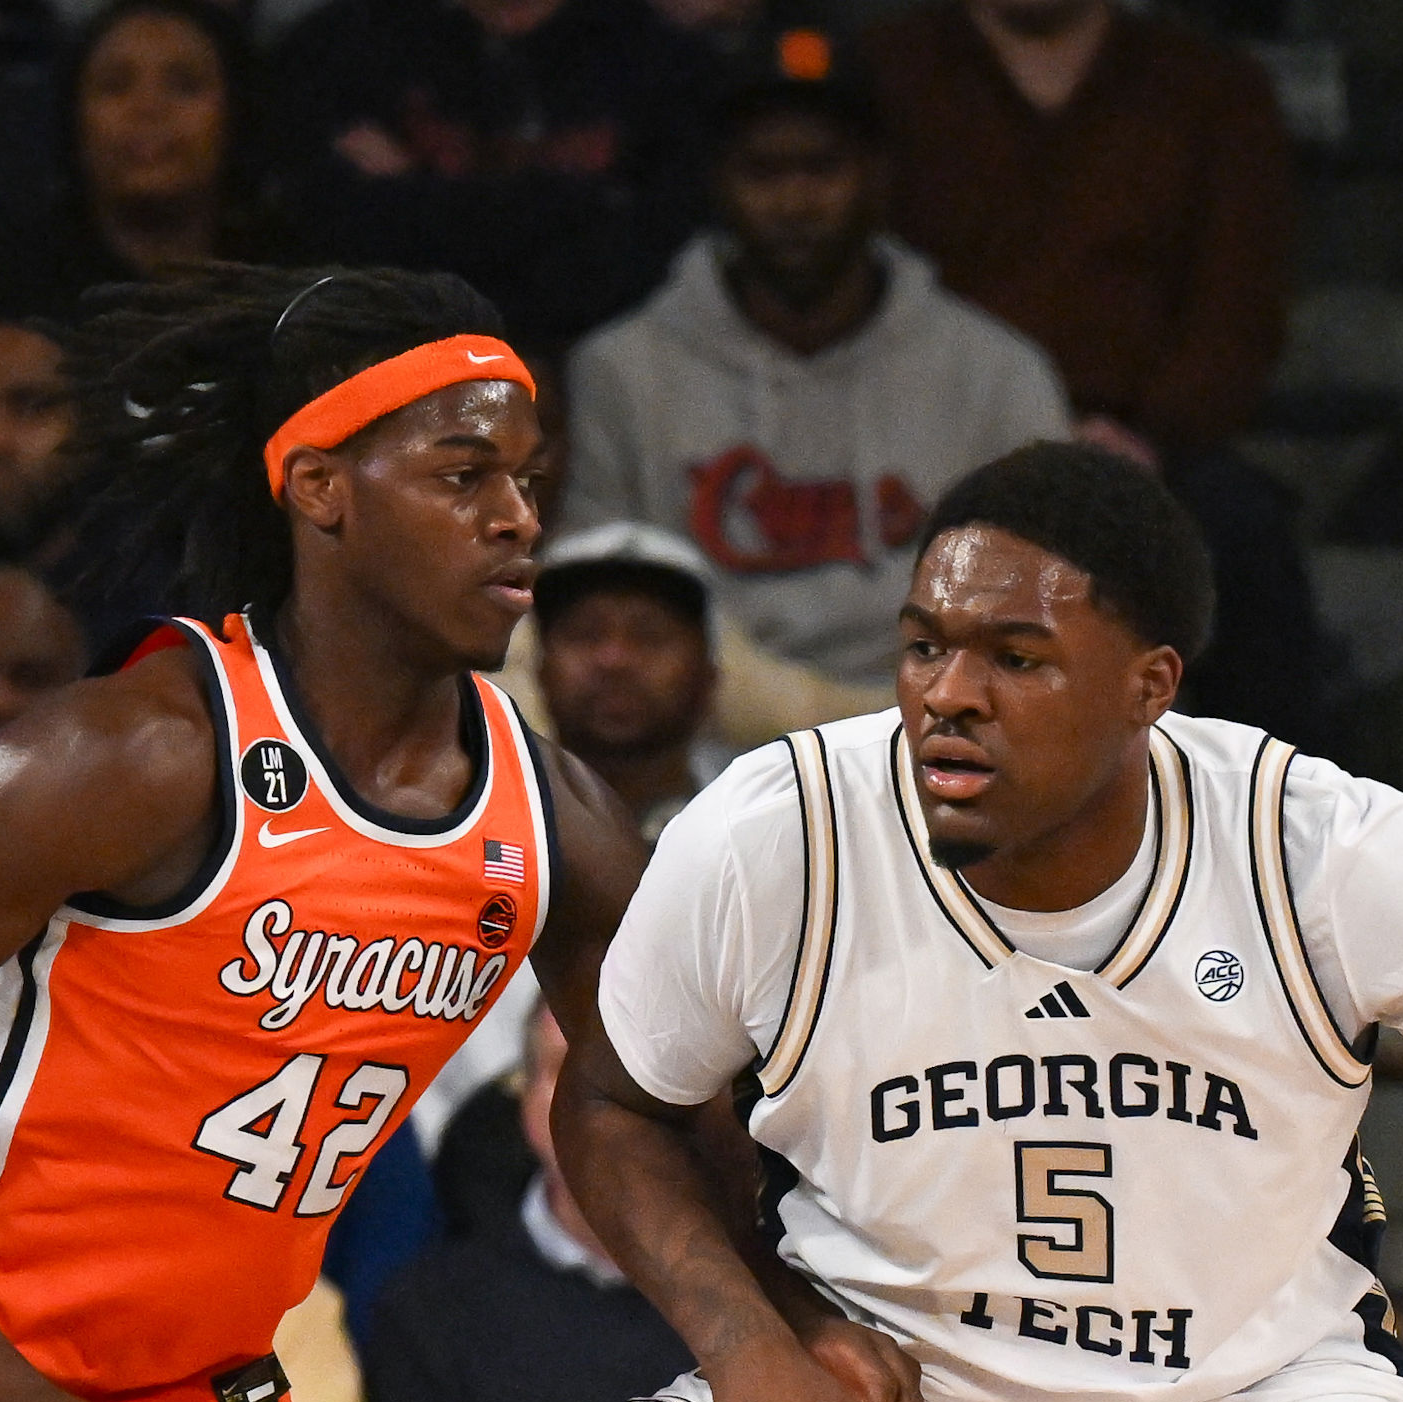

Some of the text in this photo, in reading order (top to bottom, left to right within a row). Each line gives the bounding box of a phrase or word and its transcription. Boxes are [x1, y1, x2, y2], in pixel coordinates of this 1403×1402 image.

[260, 746, 284, 770] LM
[263, 770, 288, 803] 21
[219, 898, 508, 1032] Syracuse
[1200, 962, 1241, 982] ACC
[192, 1052, 410, 1217] 42
[870, 1052, 1259, 1144] GEORGIA
[1013, 1140, 1115, 1285] 5
